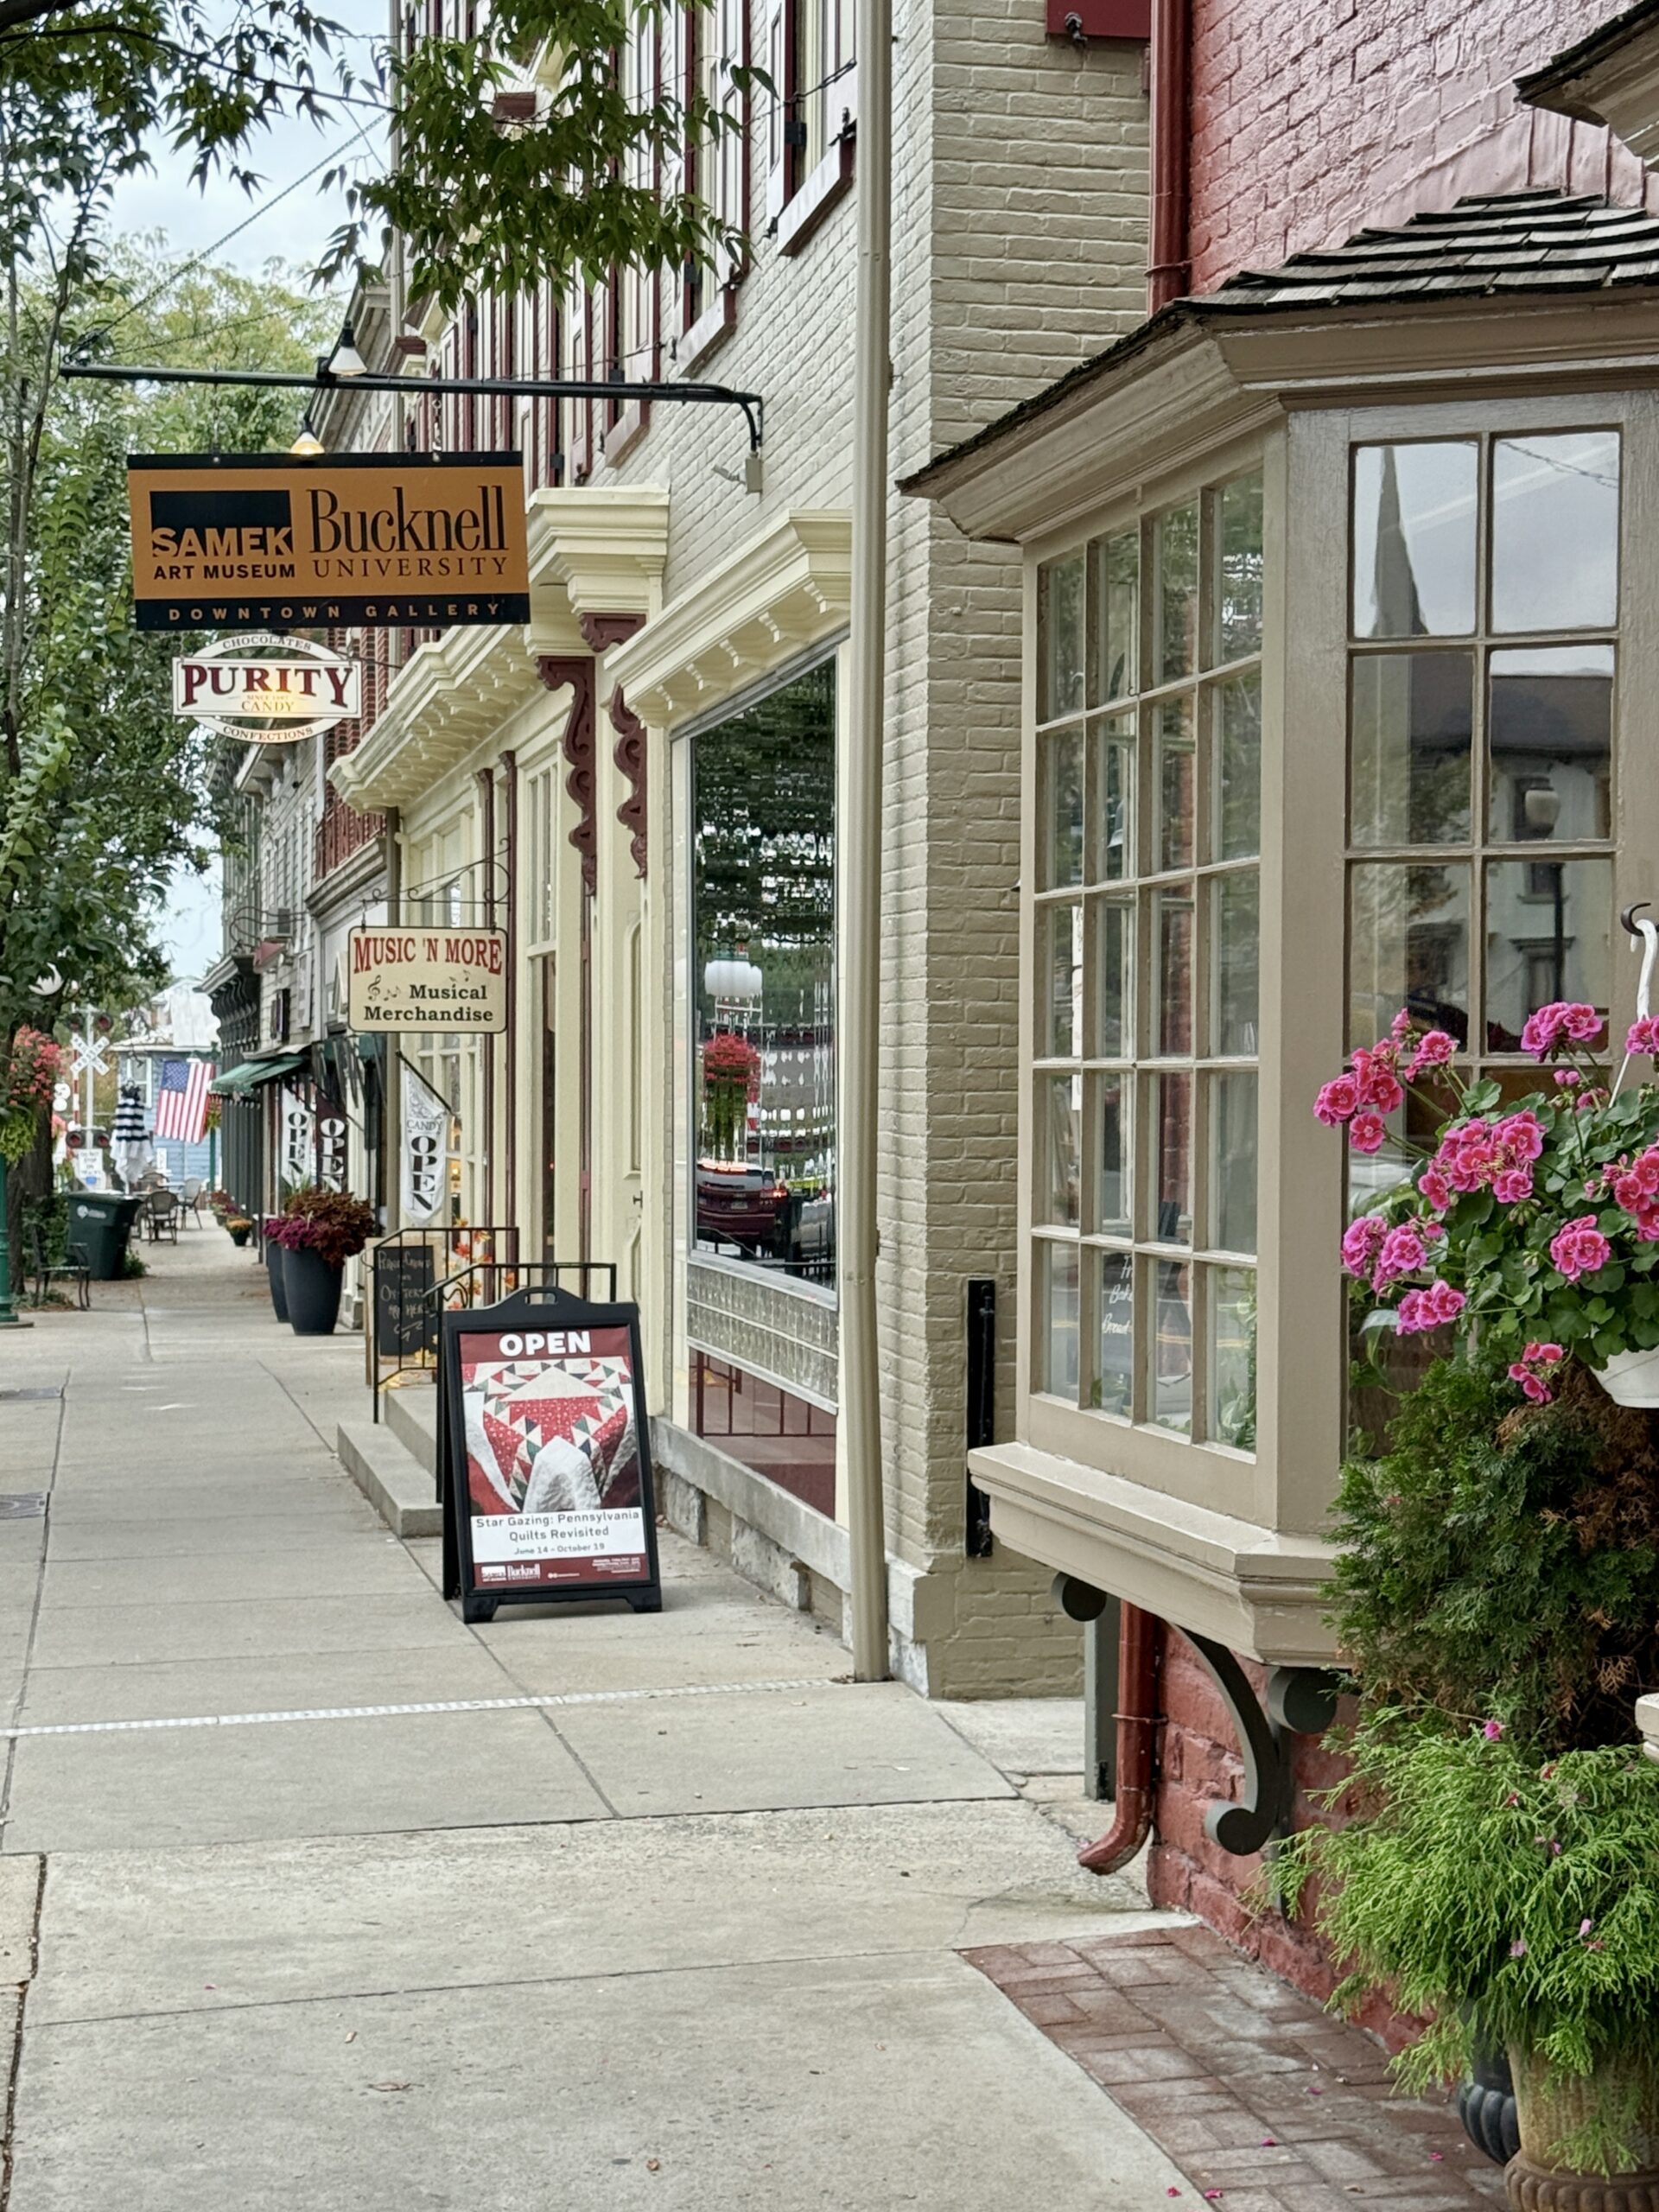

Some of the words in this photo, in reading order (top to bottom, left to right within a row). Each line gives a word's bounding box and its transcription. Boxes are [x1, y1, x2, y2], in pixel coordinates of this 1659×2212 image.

[307, 486, 509, 554] Bucknell
[151, 526, 293, 557] SAMEK
[153, 565, 194, 581] ART
[203, 563, 296, 580] MUSEUM
[312, 556, 508, 578] UNIVERSITY
[168, 606, 340, 620] DOWNTOWN
[365, 603, 499, 618] GALLERY
[222, 635, 312, 651] CHOCOLATES
[181, 664, 353, 709] PURITY
[241, 701, 295, 711] CANDY
[222, 725, 314, 741] CONFECTIONS
[353, 937, 416, 975] MUSIC
[423, 938, 439, 963] 'N
[445, 938, 503, 976] MORE
[409, 983, 488, 1001] Musical
[363, 1006, 494, 1022] Merchandise
[320, 1117, 345, 1193] OPEN
[410, 1135, 438, 1211] OPEN
[499, 1331, 591, 1357] OPEN
[476, 1518, 504, 1528] Star
[507, 1515, 554, 1528] Gazing:
[557, 1510, 639, 1523] Pennsylvania
[509, 1529, 547, 1541] Quilts
[550, 1526, 609, 1540] Revisited
[537, 1546, 549, 1554] 14
[556, 1543, 591, 1553] October
